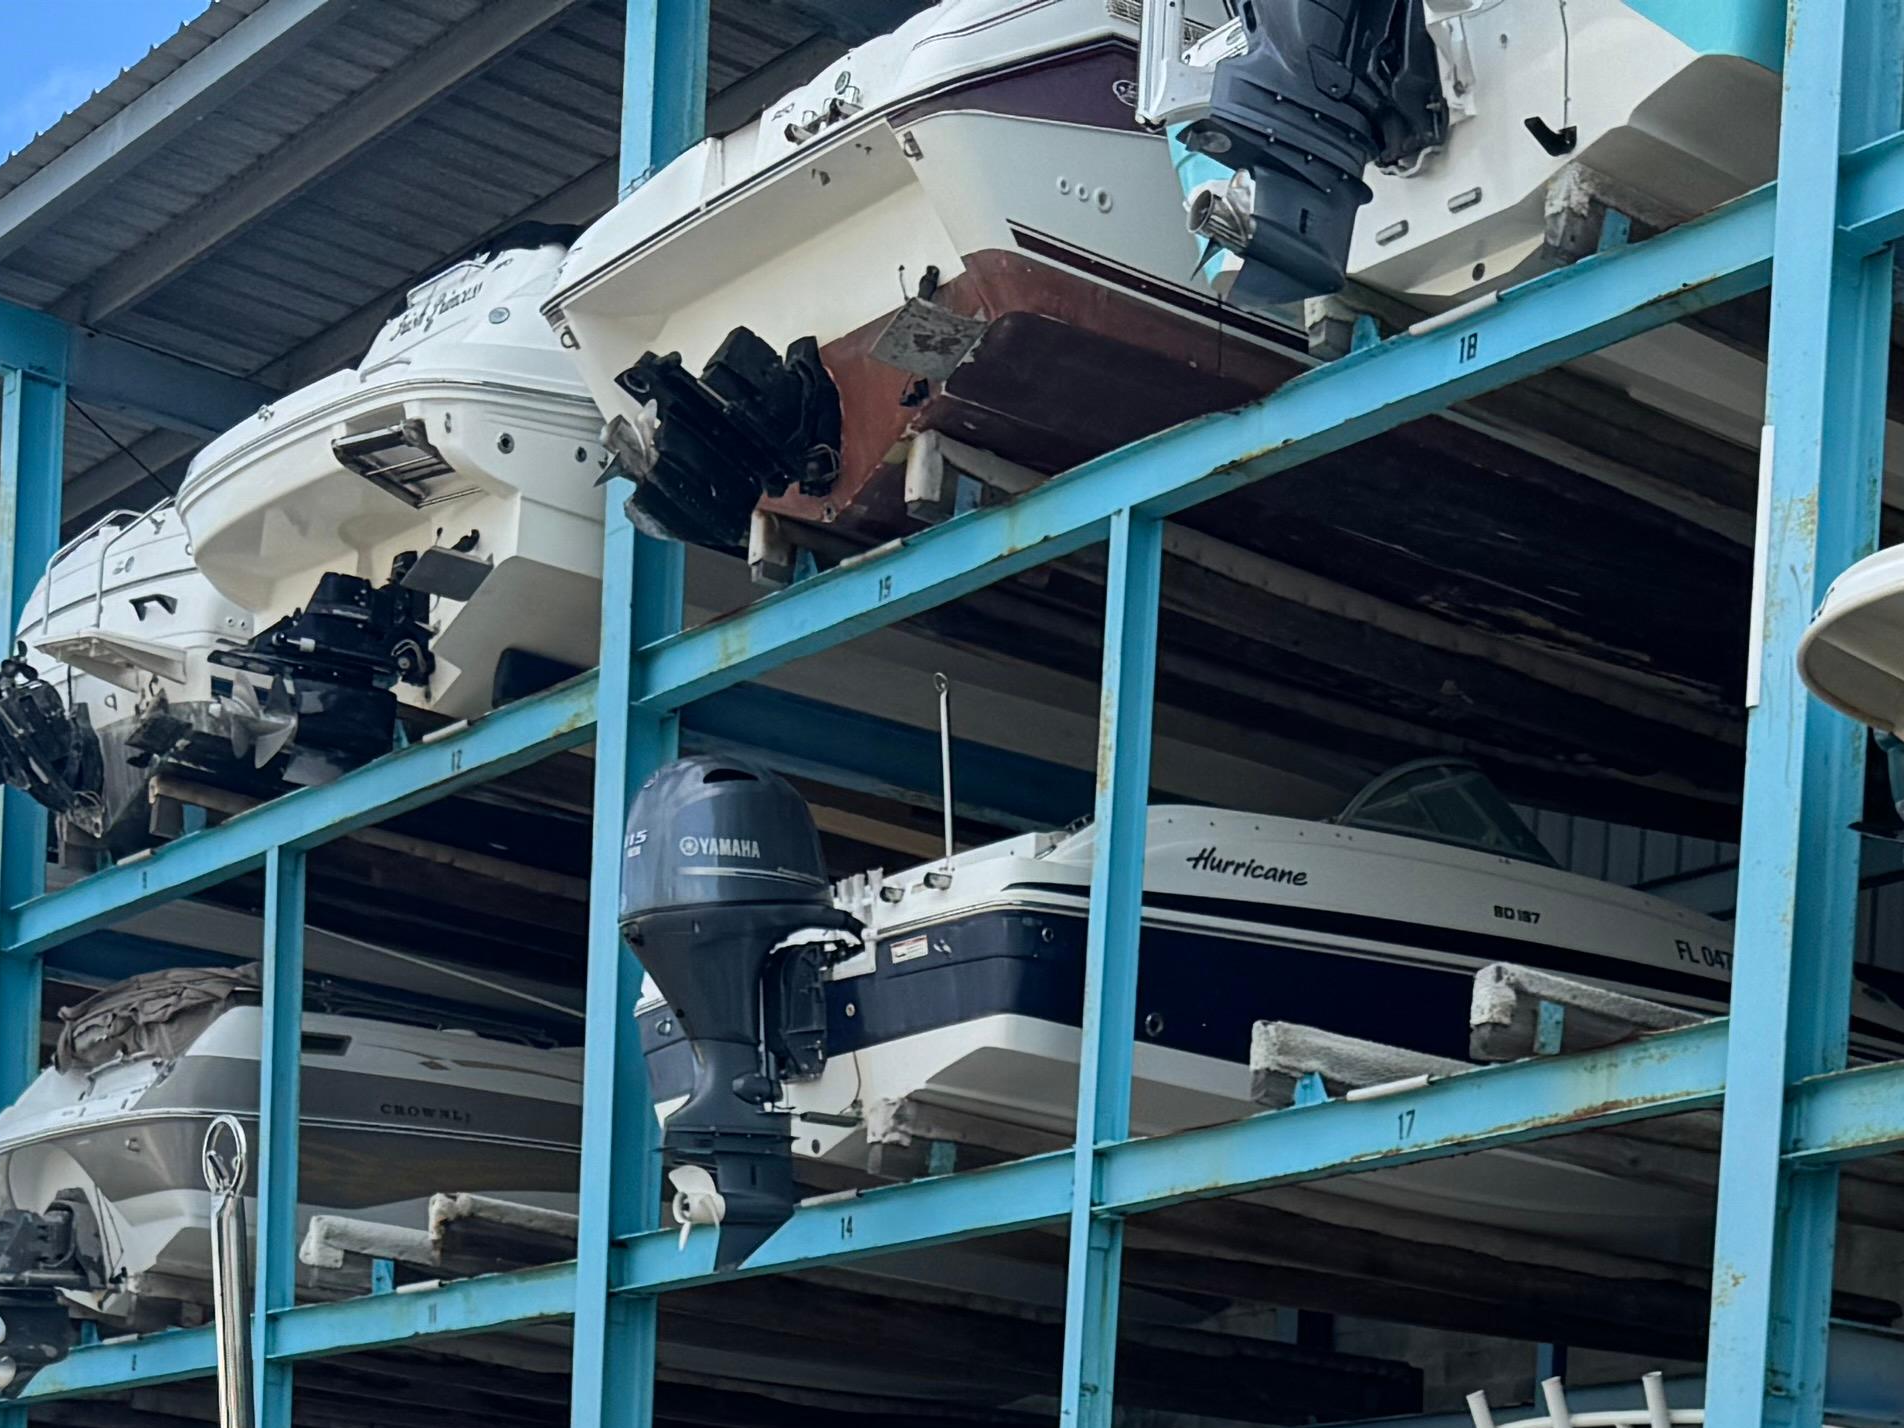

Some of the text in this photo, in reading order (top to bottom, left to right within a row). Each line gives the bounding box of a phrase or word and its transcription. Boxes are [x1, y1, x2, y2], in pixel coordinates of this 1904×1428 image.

[1459, 332, 1478, 364] 18
[699, 837, 761, 859] YAMAHA
[1185, 846, 1309, 887] Hurricane
[1674, 939, 1701, 964] FL
[1398, 1109, 1416, 1140] 17
